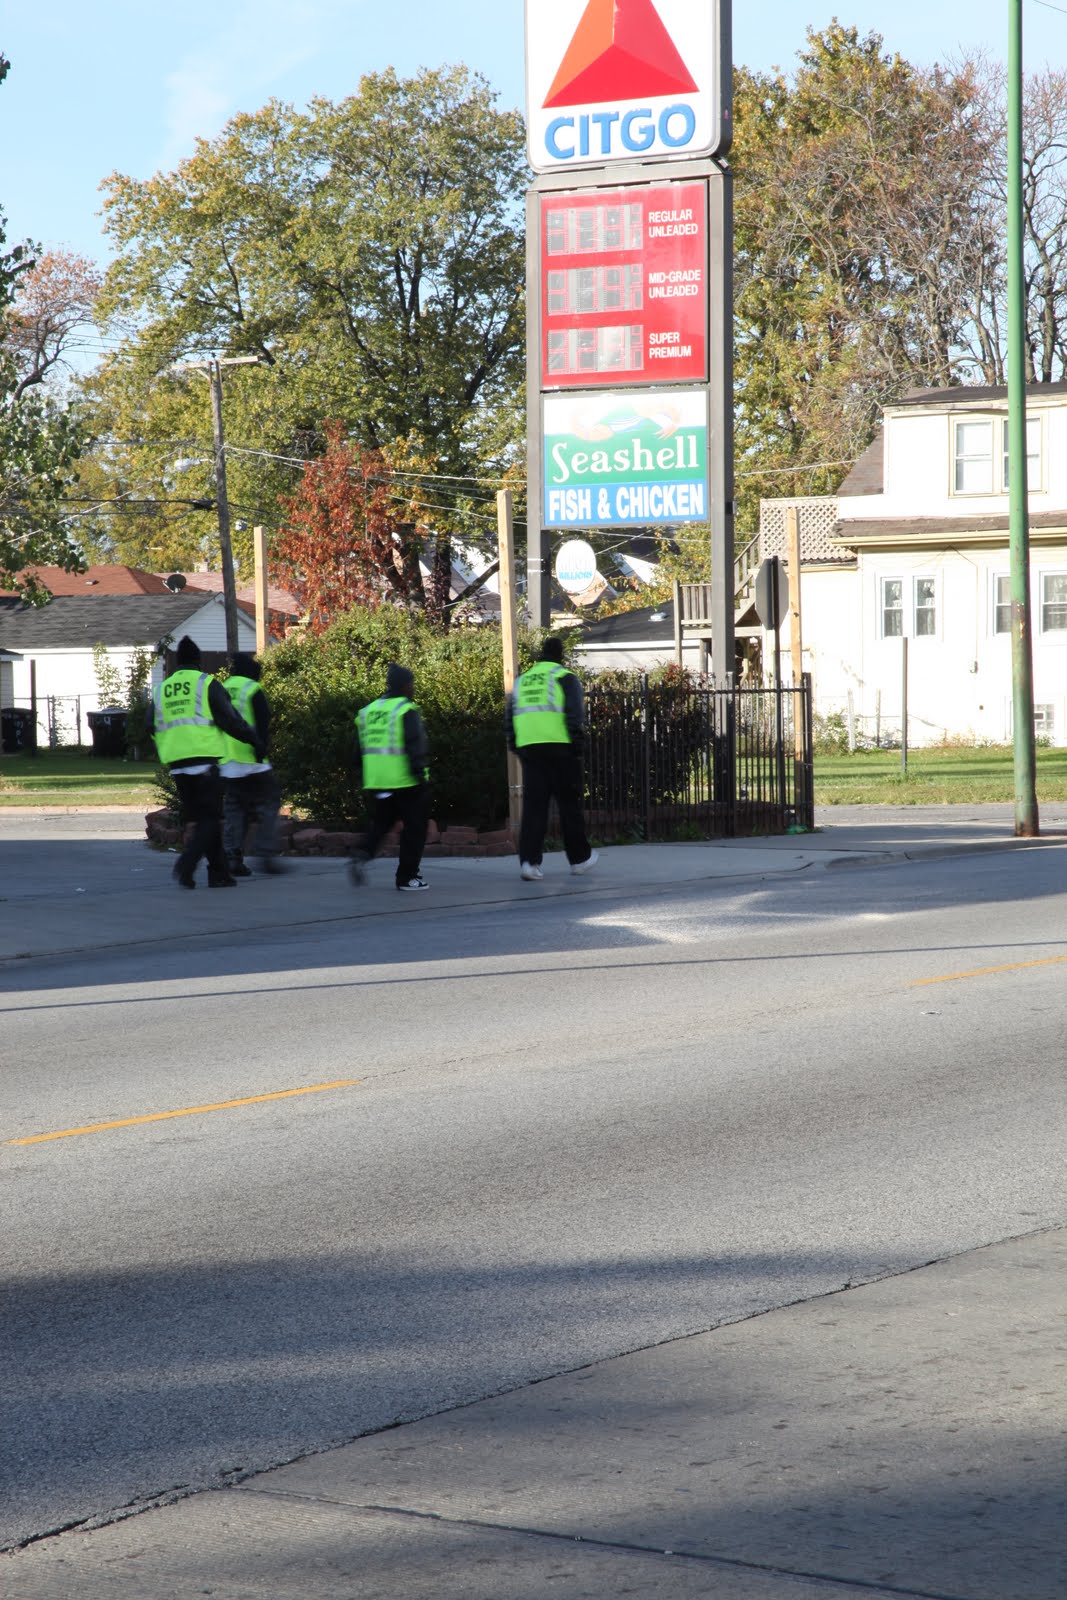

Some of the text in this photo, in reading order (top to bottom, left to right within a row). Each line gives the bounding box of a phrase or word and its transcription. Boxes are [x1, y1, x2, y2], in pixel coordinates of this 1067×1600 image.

[544, 103, 696, 160] CITGO
[649, 209, 693, 223] REGULAR
[649, 223, 699, 238] UNLEADED
[648, 269, 702, 284] MID-GRADE
[648, 284, 699, 299] UNLEADED
[649, 331, 680, 345] SUPER
[649, 345, 692, 359] PREMIUM
[552, 435, 699, 483] Seashell
[549, 484, 704, 520] FISH & CHICKEN
[164, 681, 191, 698] CPS
